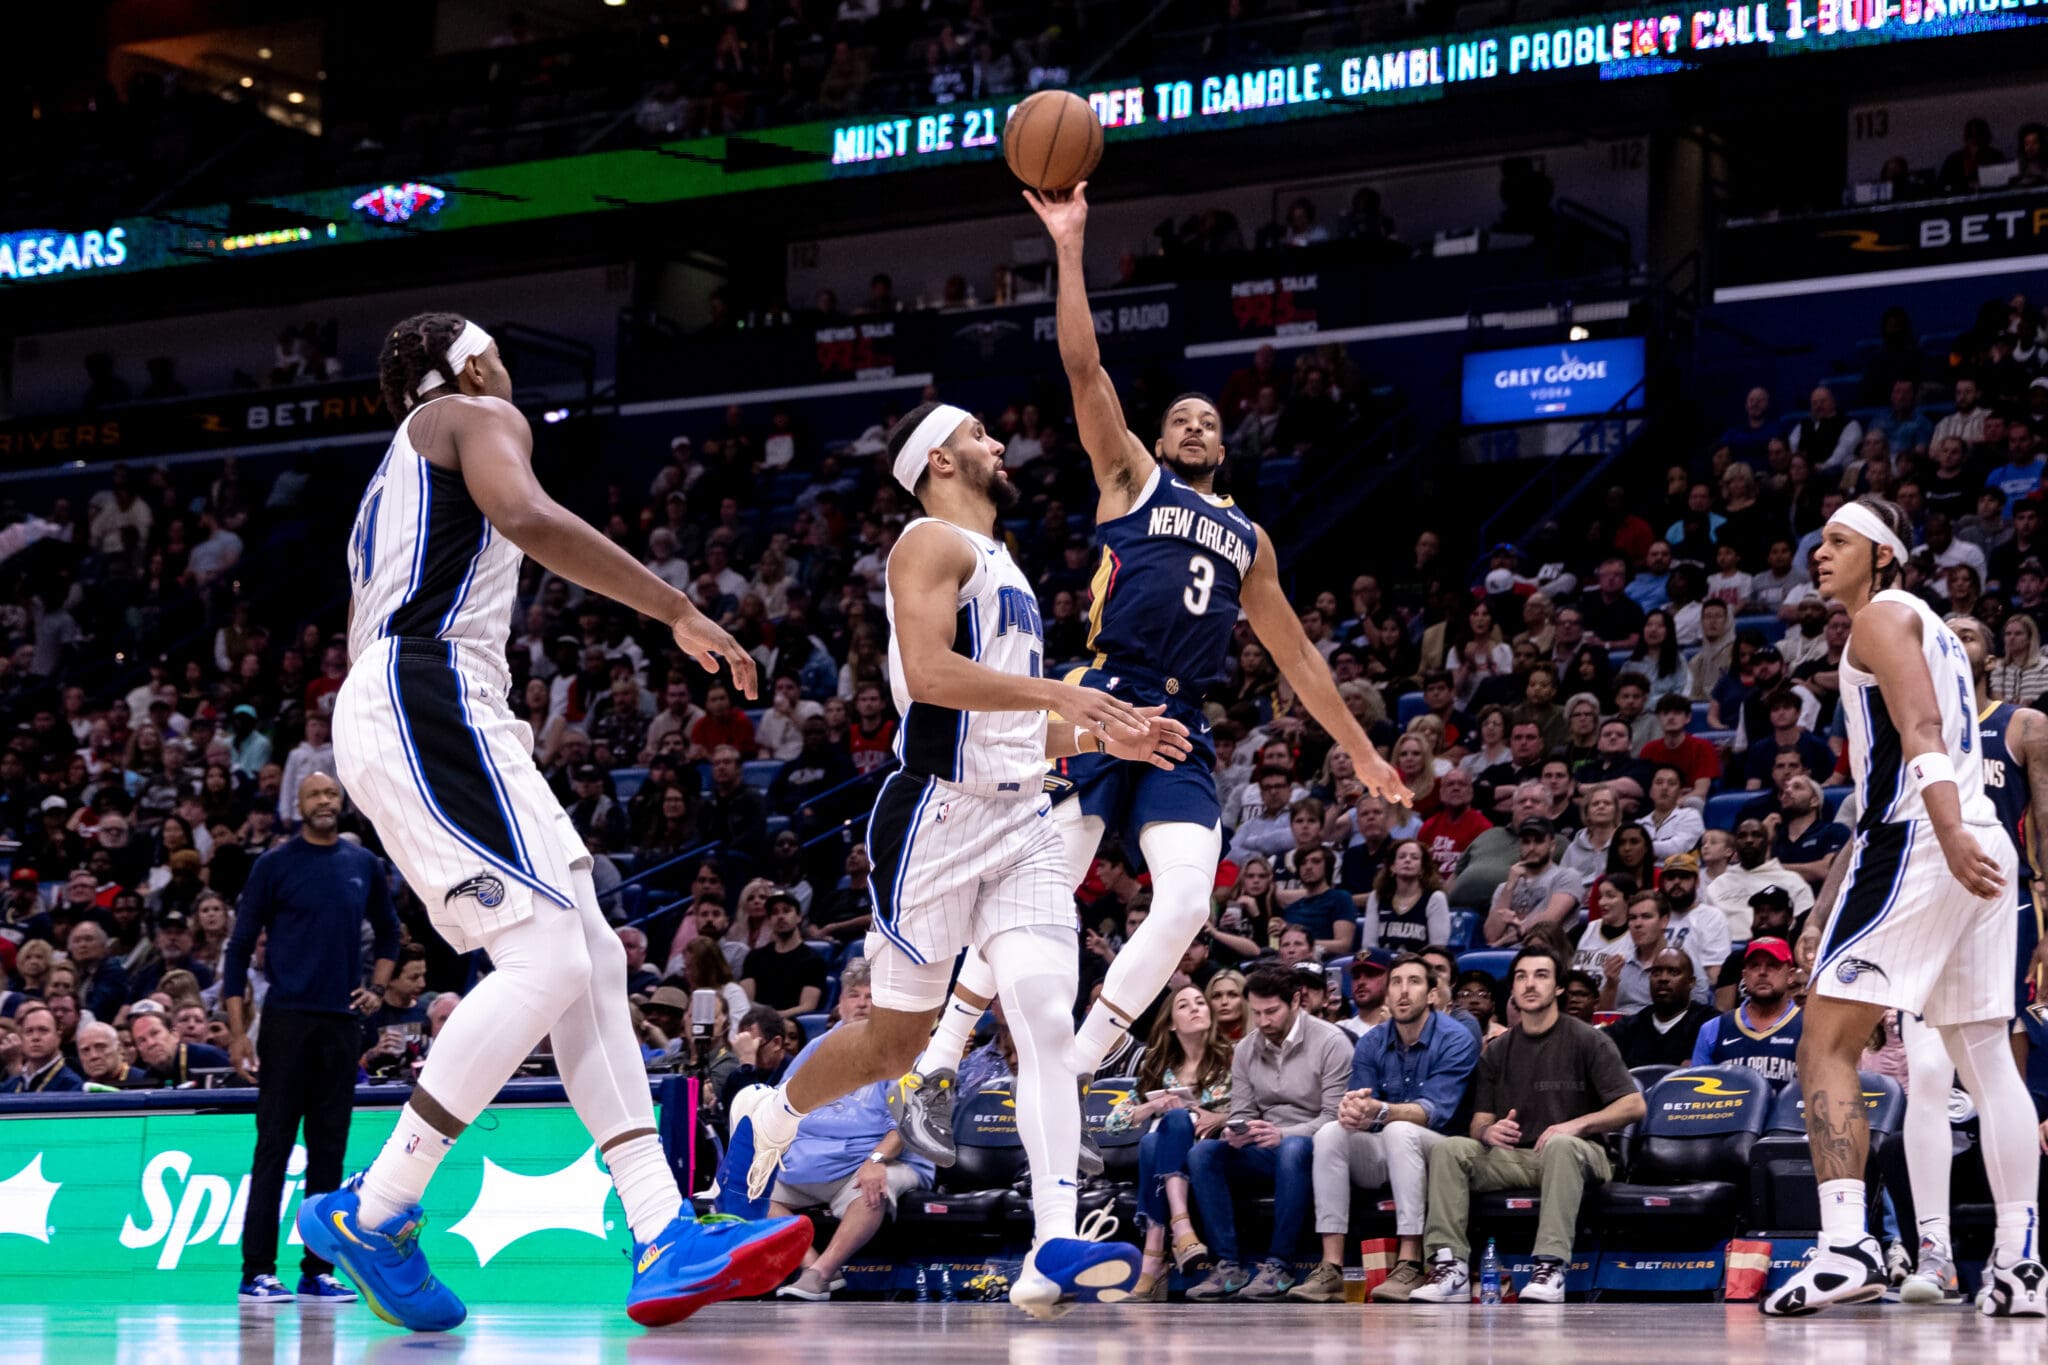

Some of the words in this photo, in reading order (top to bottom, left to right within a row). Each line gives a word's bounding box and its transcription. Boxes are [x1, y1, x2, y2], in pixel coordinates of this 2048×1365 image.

[832, 118, 912, 164] MUST
[917, 113, 954, 153] BE
[962, 107, 997, 147] 21
[1154, 80, 1193, 122] TO
[1201, 63, 1333, 115] GAMBLE.
[1341, 39, 1498, 97] GAMBLING
[1692, 3, 1775, 50] CALL
[1854, 110, 1888, 139] 113
[1609, 143, 1643, 170] 112
[1118, 302, 1170, 332] RADIO
[1494, 367, 1542, 389] GREY
[1544, 360, 1608, 384] GOOSE
[246, 395, 386, 431] BETRIV
[1148, 506, 1195, 538] NEW
[1195, 515, 1252, 581] ORLEAN
[1183, 554, 1216, 616] 3
[1663, 1099, 1743, 1111] BETRIVERS
[1667, 1112, 1735, 1121] SPORTSBOOK
[1634, 1260, 1716, 1271] BETRIVERS
